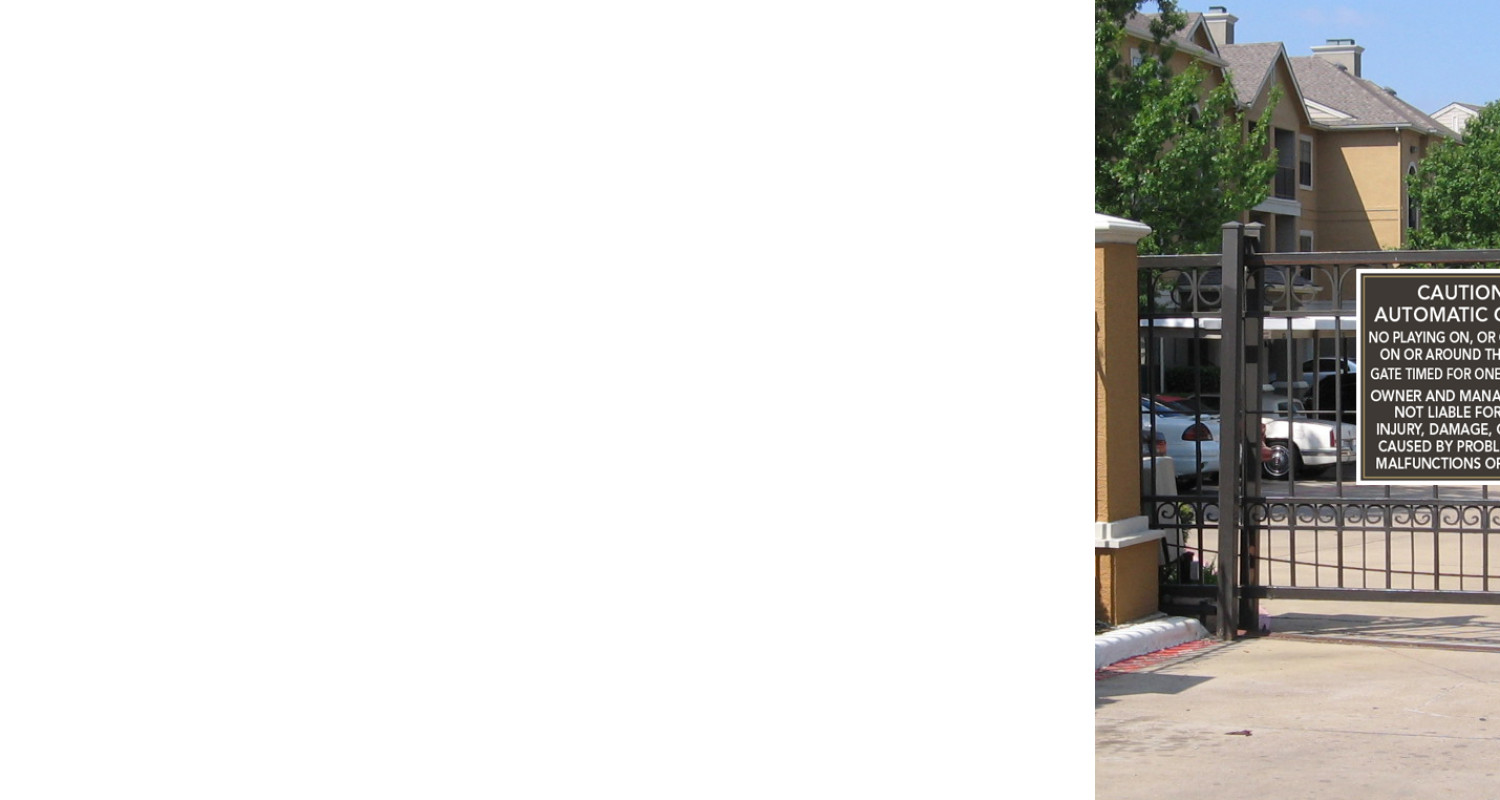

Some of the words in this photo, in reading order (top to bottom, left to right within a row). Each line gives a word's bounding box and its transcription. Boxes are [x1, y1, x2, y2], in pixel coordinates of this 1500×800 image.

[1374, 307, 1488, 322] AUTOMATIC
[1369, 331, 1389, 343] NO
[1393, 331, 1445, 343] PLAYING
[1449, 331, 1473, 345] ON,
[1477, 331, 1495, 343] OR
[1380, 348, 1400, 360] ON
[1404, 348, 1422, 360] OR
[1425, 348, 1481, 360] AROUND
[1371, 368, 1402, 380] GATE
[1405, 368, 1443, 380] TIMED
[1447, 368, 1471, 380] FOR
[1475, 368, 1500, 380] ONE
[1371, 390, 1422, 401] OWNER
[1425, 389, 1455, 402] AND
[1395, 406, 1424, 418] NOT
[1428, 406, 1471, 418] LIABLE
[1377, 423, 1424, 436] INJURY,
[1430, 423, 1492, 437] DAMAGE,
[1378, 440, 1432, 452] CAUSED
[1436, 440, 1453, 452] BY
[1376, 457, 1481, 469] MALFUNCTIONS
